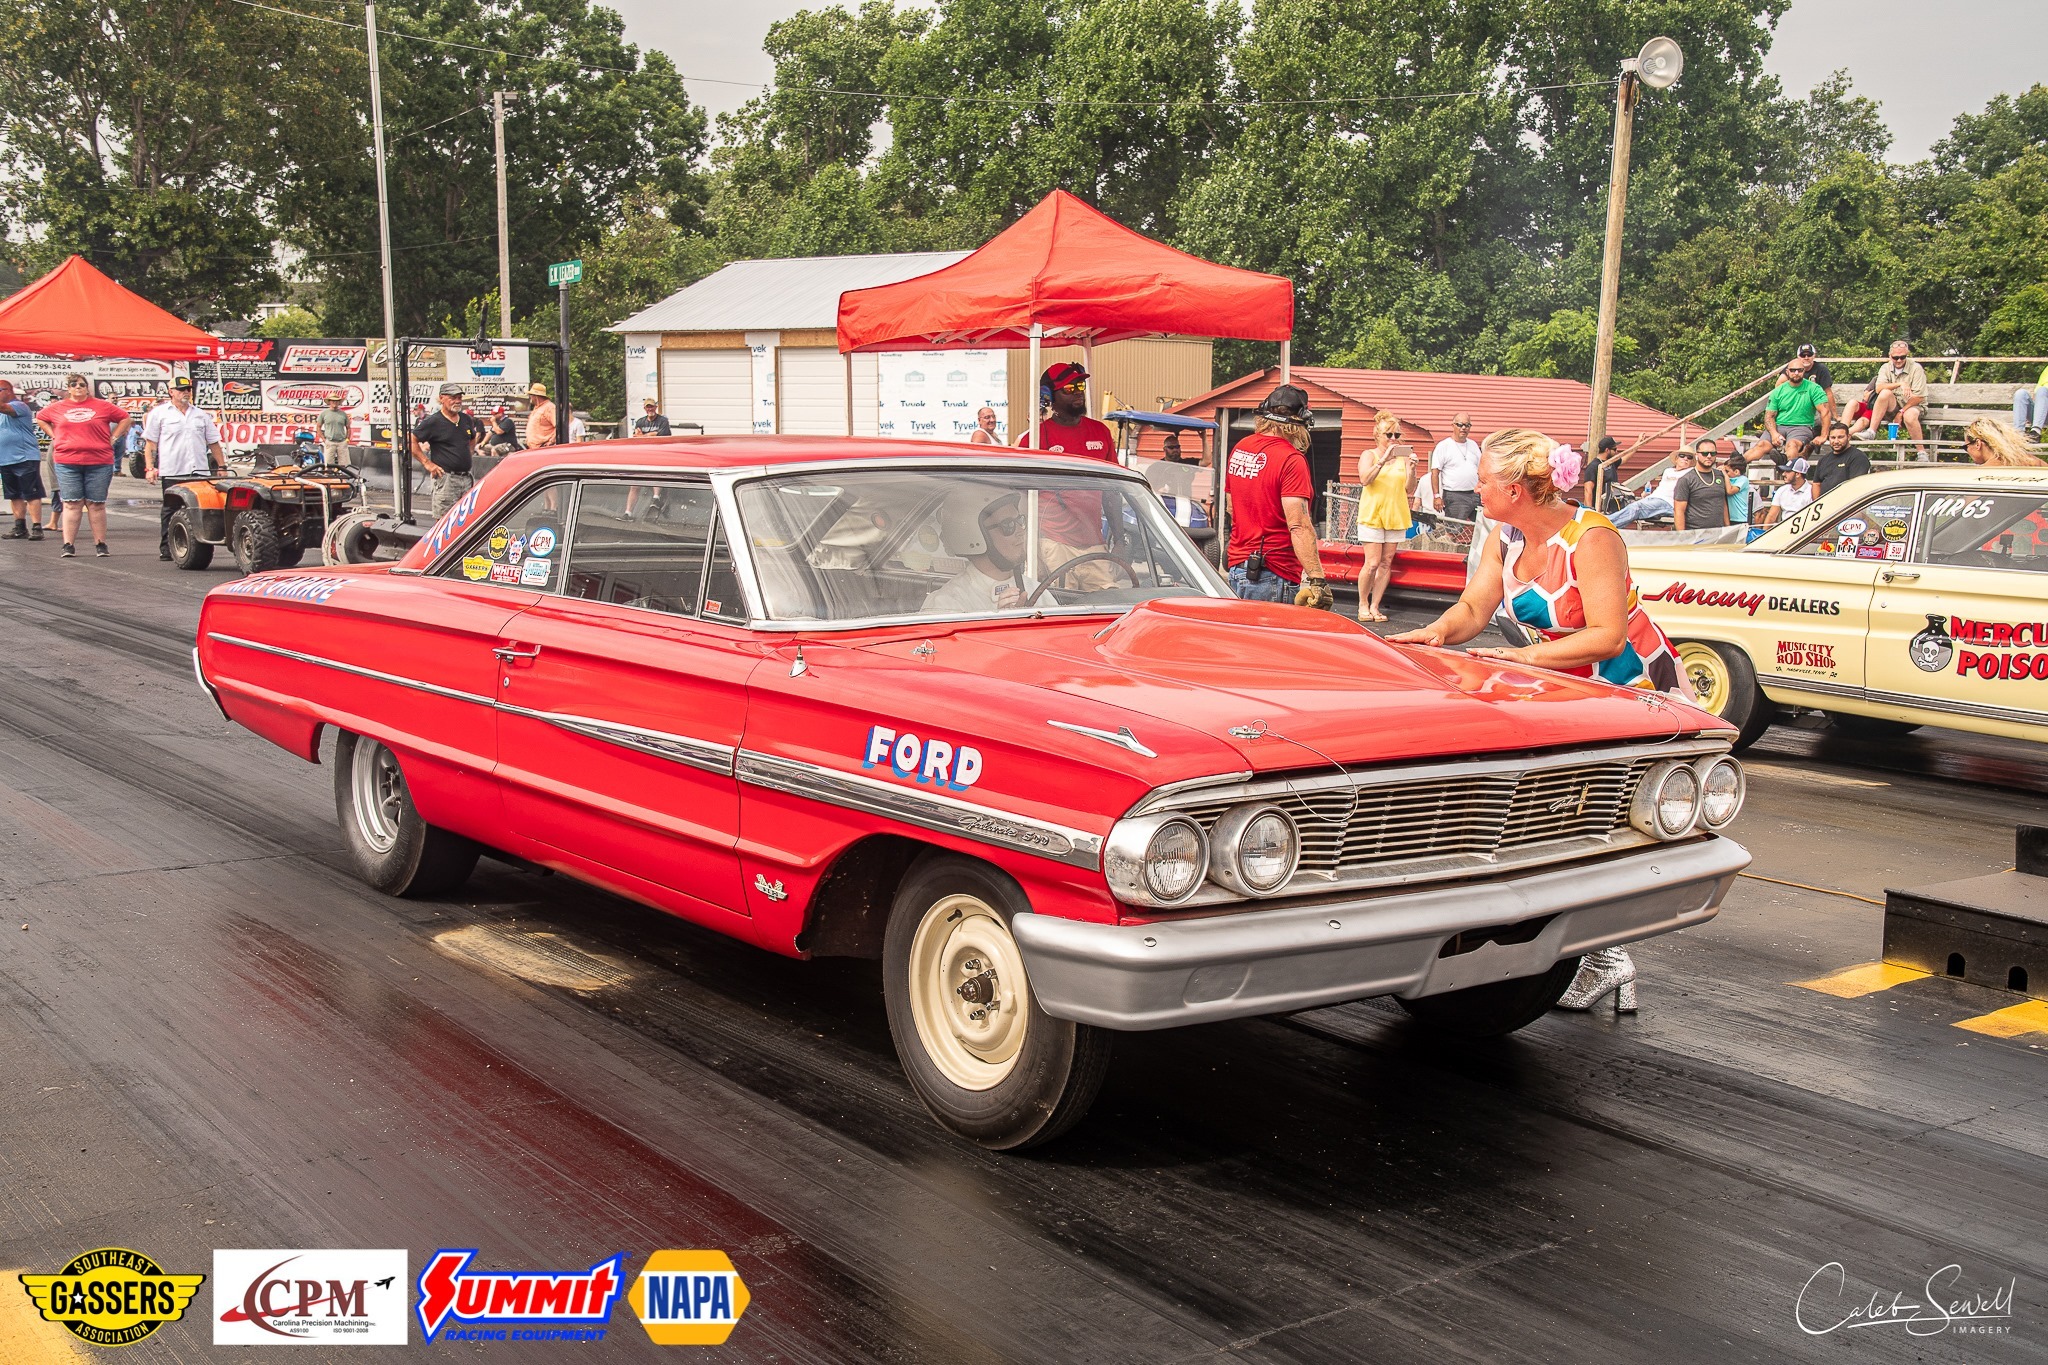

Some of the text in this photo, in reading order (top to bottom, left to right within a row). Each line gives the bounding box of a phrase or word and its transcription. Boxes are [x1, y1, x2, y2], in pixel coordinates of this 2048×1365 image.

[752, 344, 767, 353] vek
[20, 379, 70, 391] HIGGINS
[98, 381, 170, 398] OUTLA
[196, 380, 221, 394] PRO
[219, 413, 288, 423] WINNERS
[752, 420, 772, 430] yvek
[879, 421, 895, 430] vek
[910, 421, 937, 432] Tyvek
[1228, 462, 1260, 480] STAFF
[1926, 498, 1995, 519] MR65
[1790, 503, 1824, 535] S/S
[1842, 523, 1862, 532] CPM
[536, 535, 552, 548] CPM
[493, 566, 520, 577] WHITE
[1642, 581, 1841, 616] Mercury DEALERS
[1950, 614, 2048, 648] MERCU
[1776, 640, 1835, 658] MUSIC CITY
[1776, 651, 1837, 669] ROD SHOP
[1956, 649, 2048, 681] POISO
[863, 725, 984, 792] FORD
